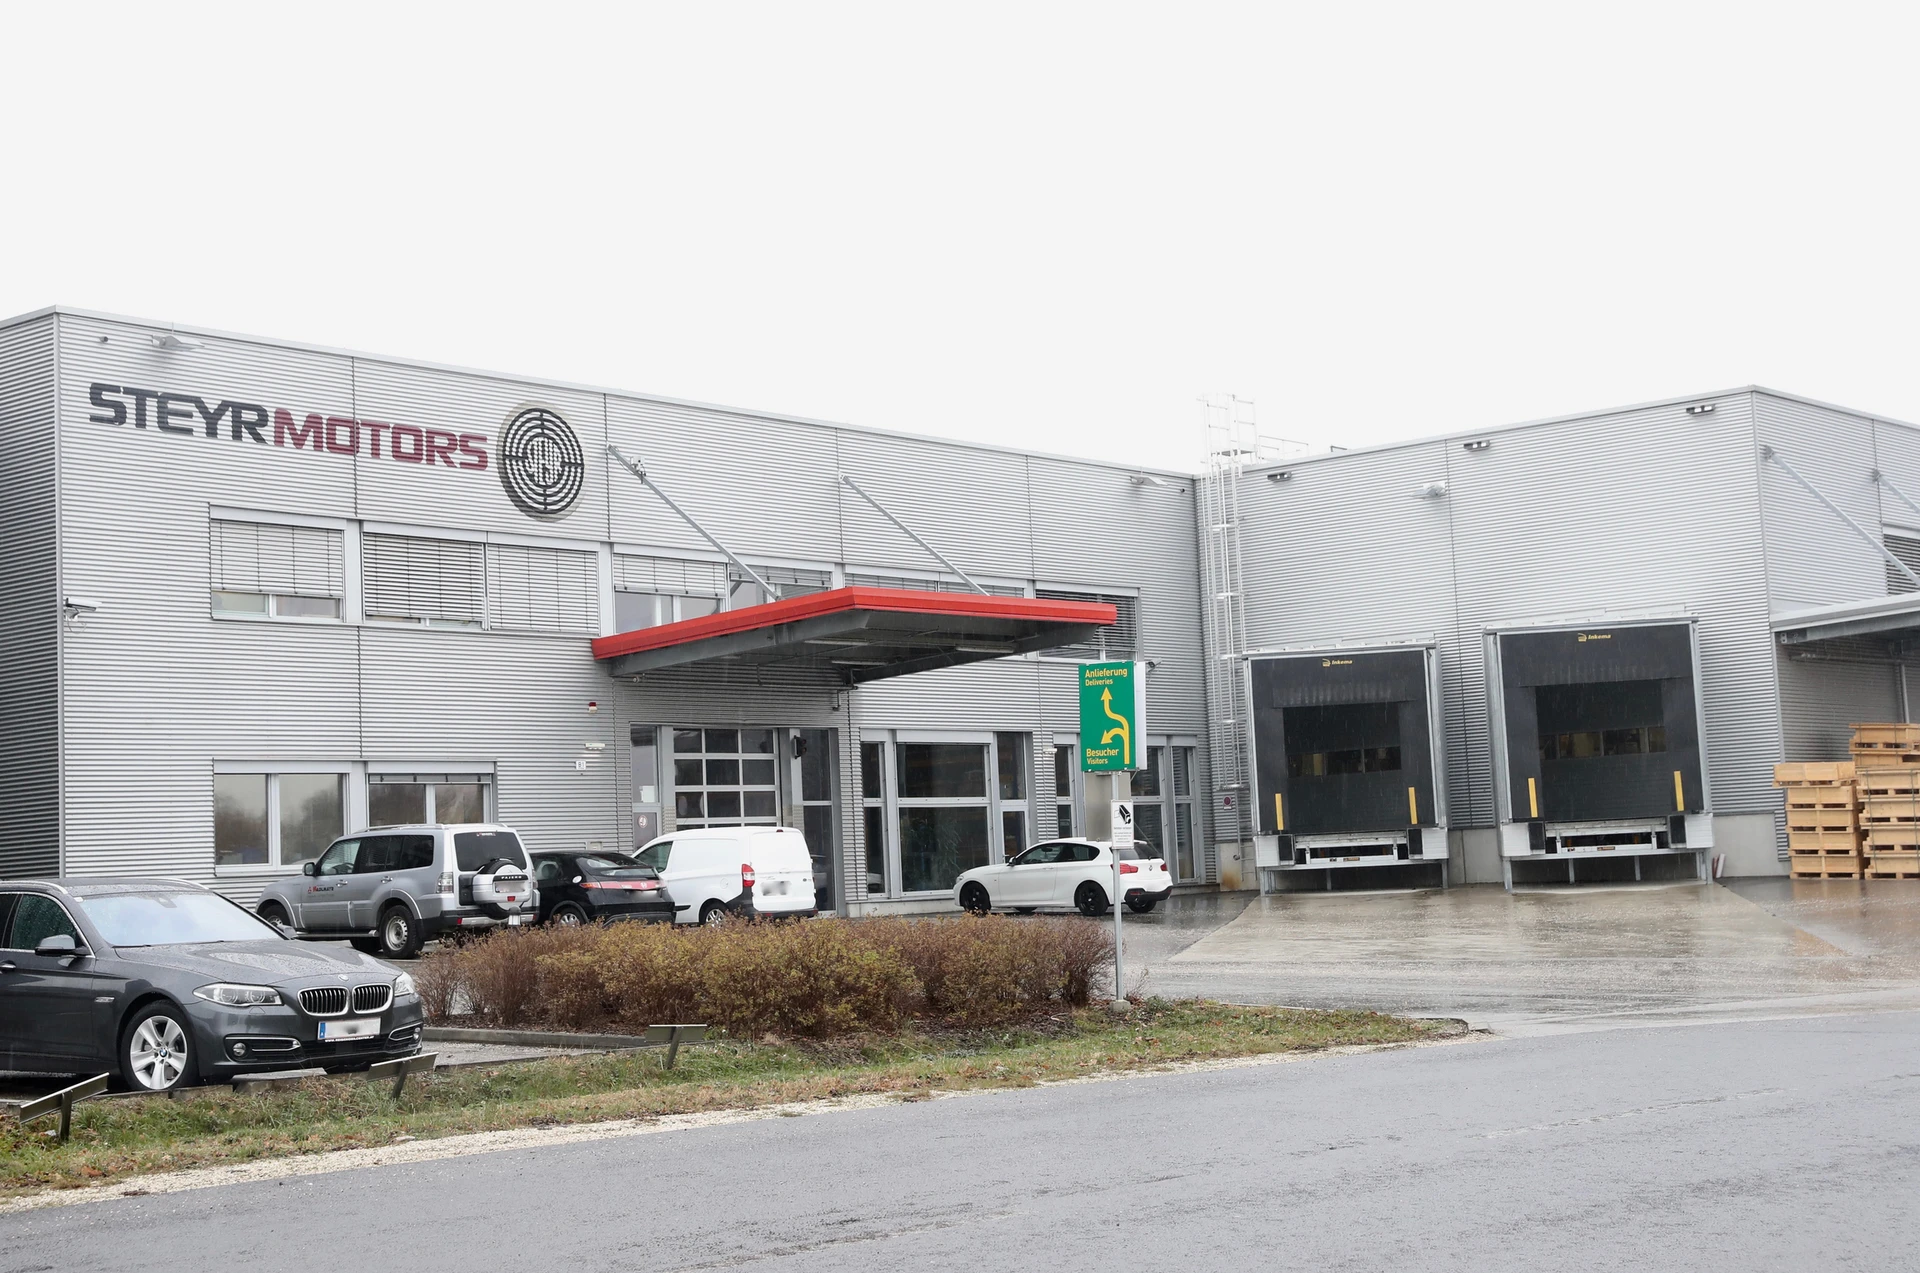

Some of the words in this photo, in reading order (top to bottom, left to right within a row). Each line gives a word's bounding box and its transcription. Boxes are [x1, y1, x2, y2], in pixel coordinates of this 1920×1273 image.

[89, 382, 269, 444] STEYR
[273, 407, 488, 471] MOTORS
[1085, 668, 1128, 678] Anlieferung
[1085, 678, 1114, 686] Deliveries
[1086, 748, 1119, 757] Besucher
